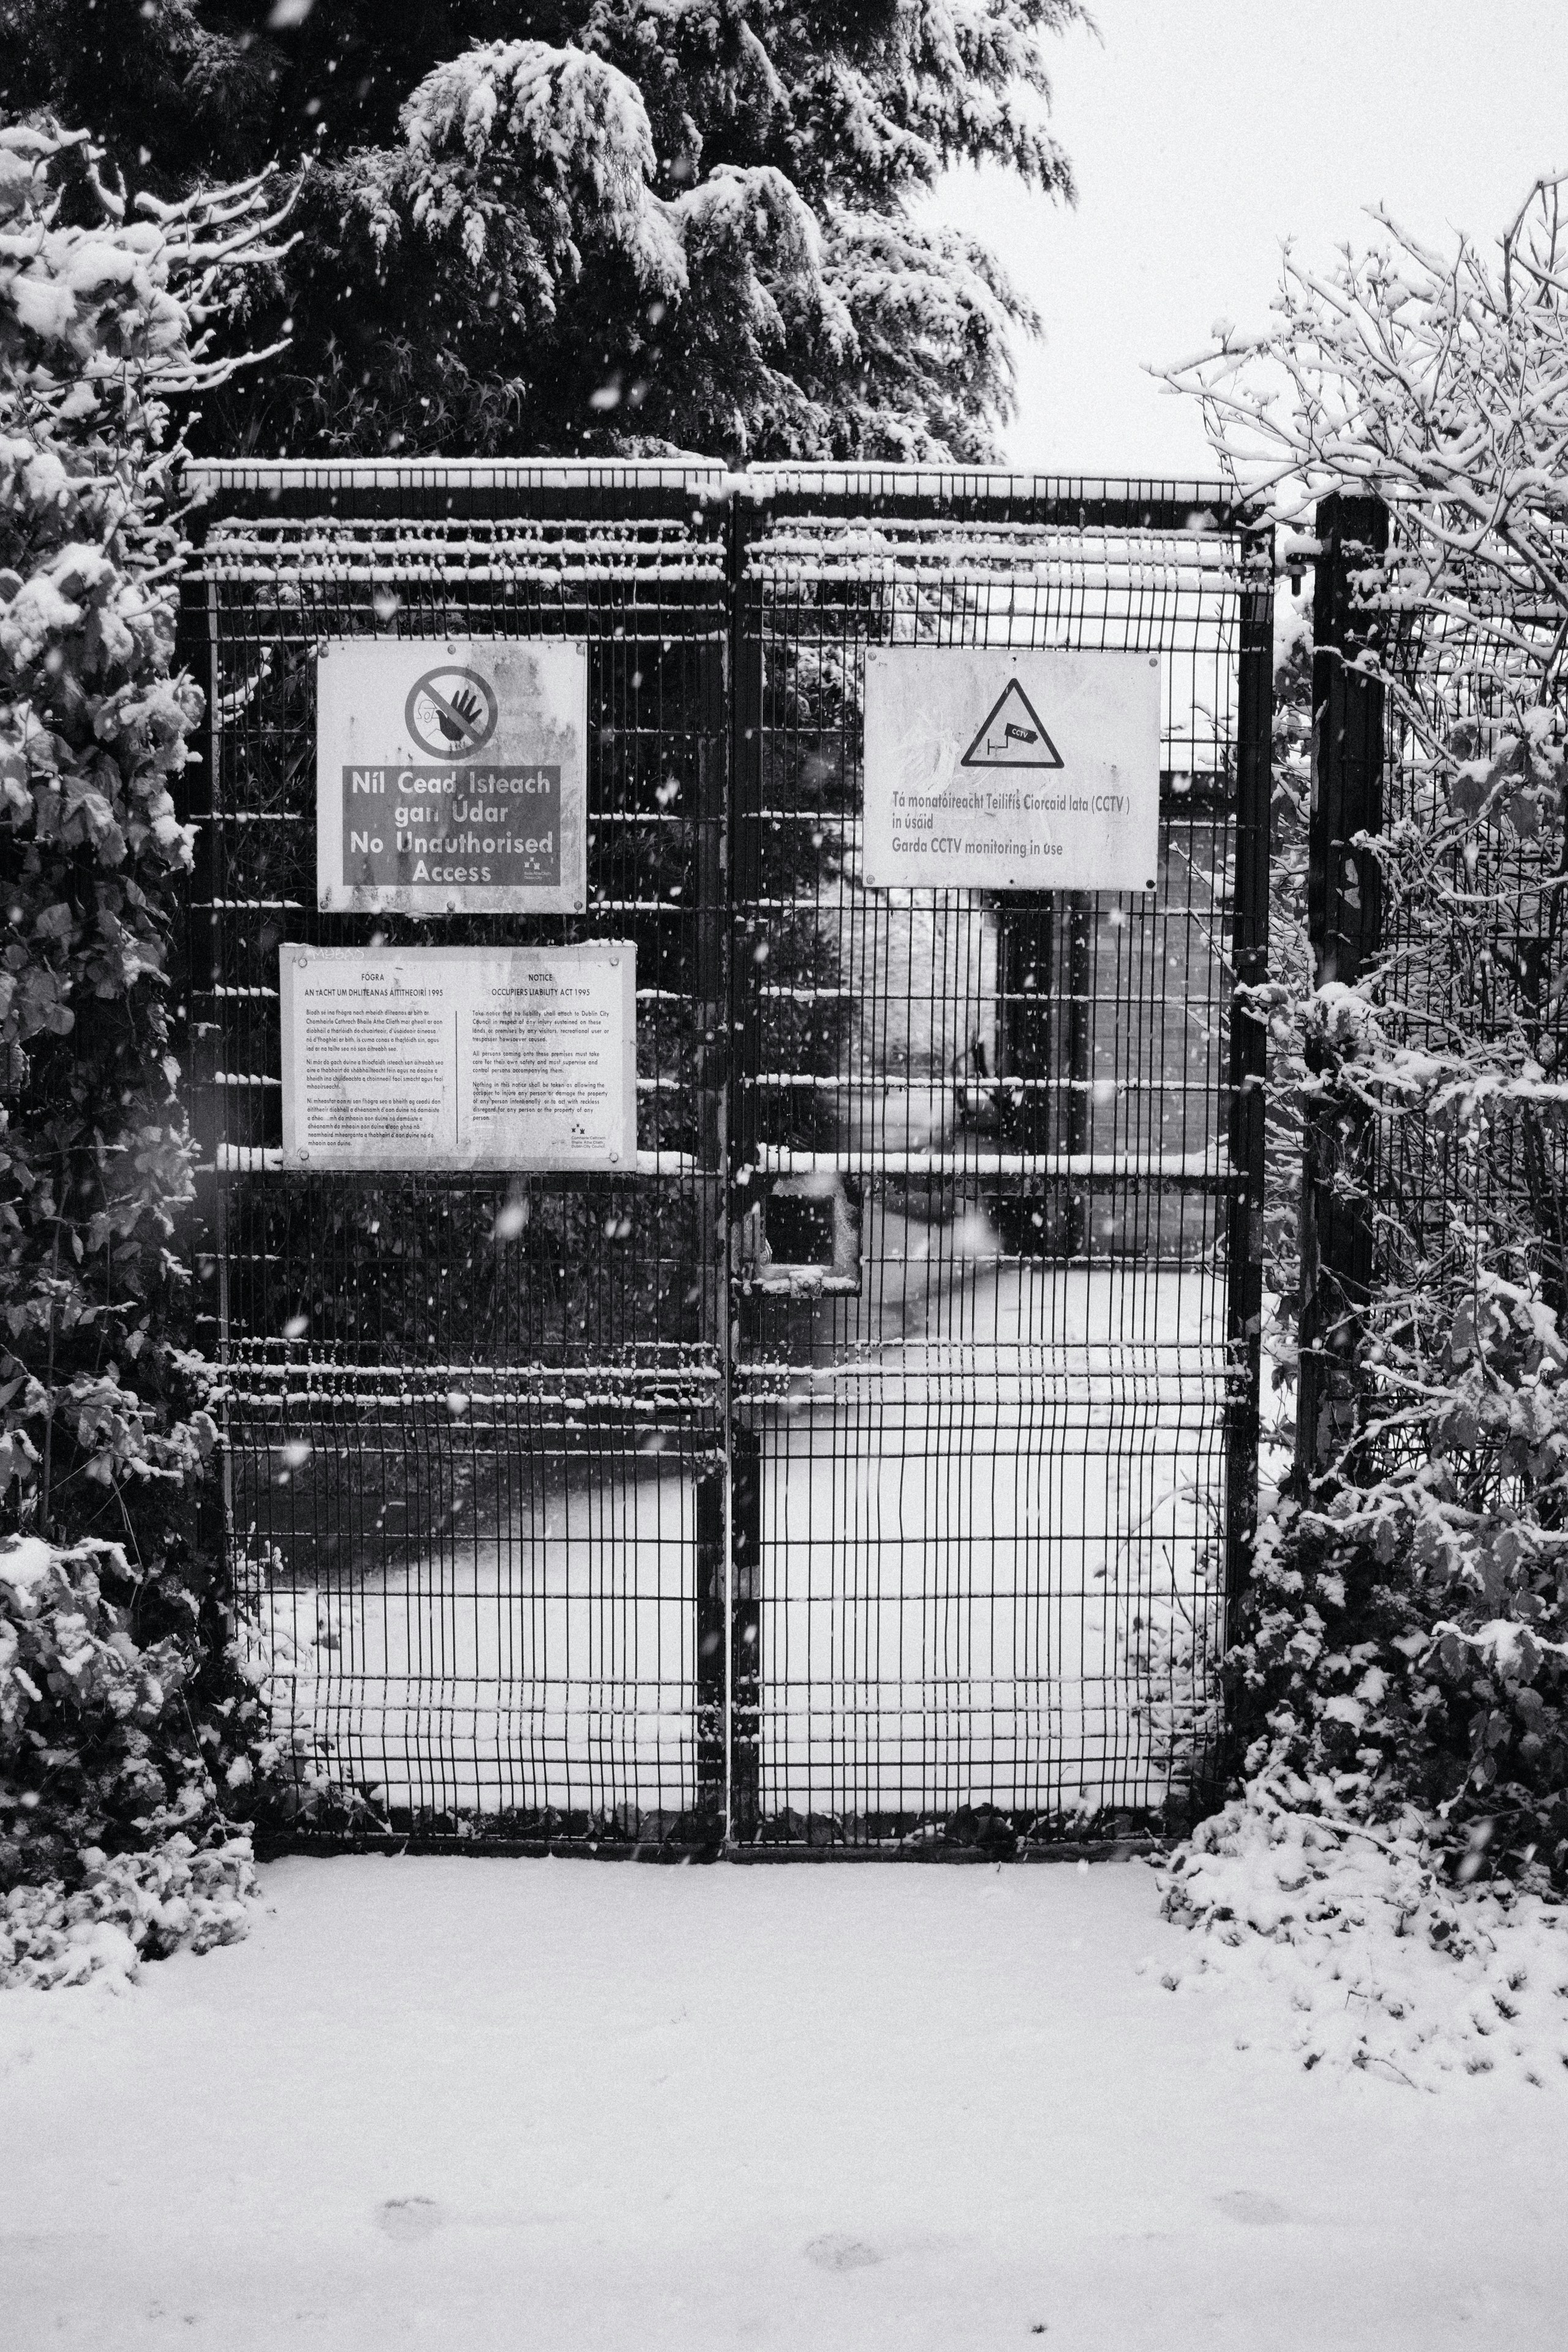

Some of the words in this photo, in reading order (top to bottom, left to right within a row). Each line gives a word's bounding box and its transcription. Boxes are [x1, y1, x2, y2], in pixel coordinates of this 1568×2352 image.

[1012, 728, 1028, 738] CCTV
[352, 771, 384, 793] Níl
[398, 771, 456, 793] Cead
[470, 771, 549, 793] Isteach
[395, 805, 439, 827] gan
[452, 794, 508, 822] Údar
[892, 791, 905, 807] Tá
[908, 792, 984, 810] monatóireacht
[986, 792, 1020, 810] Teilifís
[1023, 793, 1066, 811] Ciorcaid
[892, 813, 902, 829] in
[905, 813, 933, 829] úsáid
[350, 831, 383, 853] No
[397, 831, 552, 853] Unauthorised
[892, 837, 927, 853] Garda
[931, 838, 962, 853] CCTV
[965, 839, 1027, 858] monitoring
[1030, 840, 1040, 854] in
[413, 860, 491, 881] Access
[361, 972, 384, 981] FÓGRA
